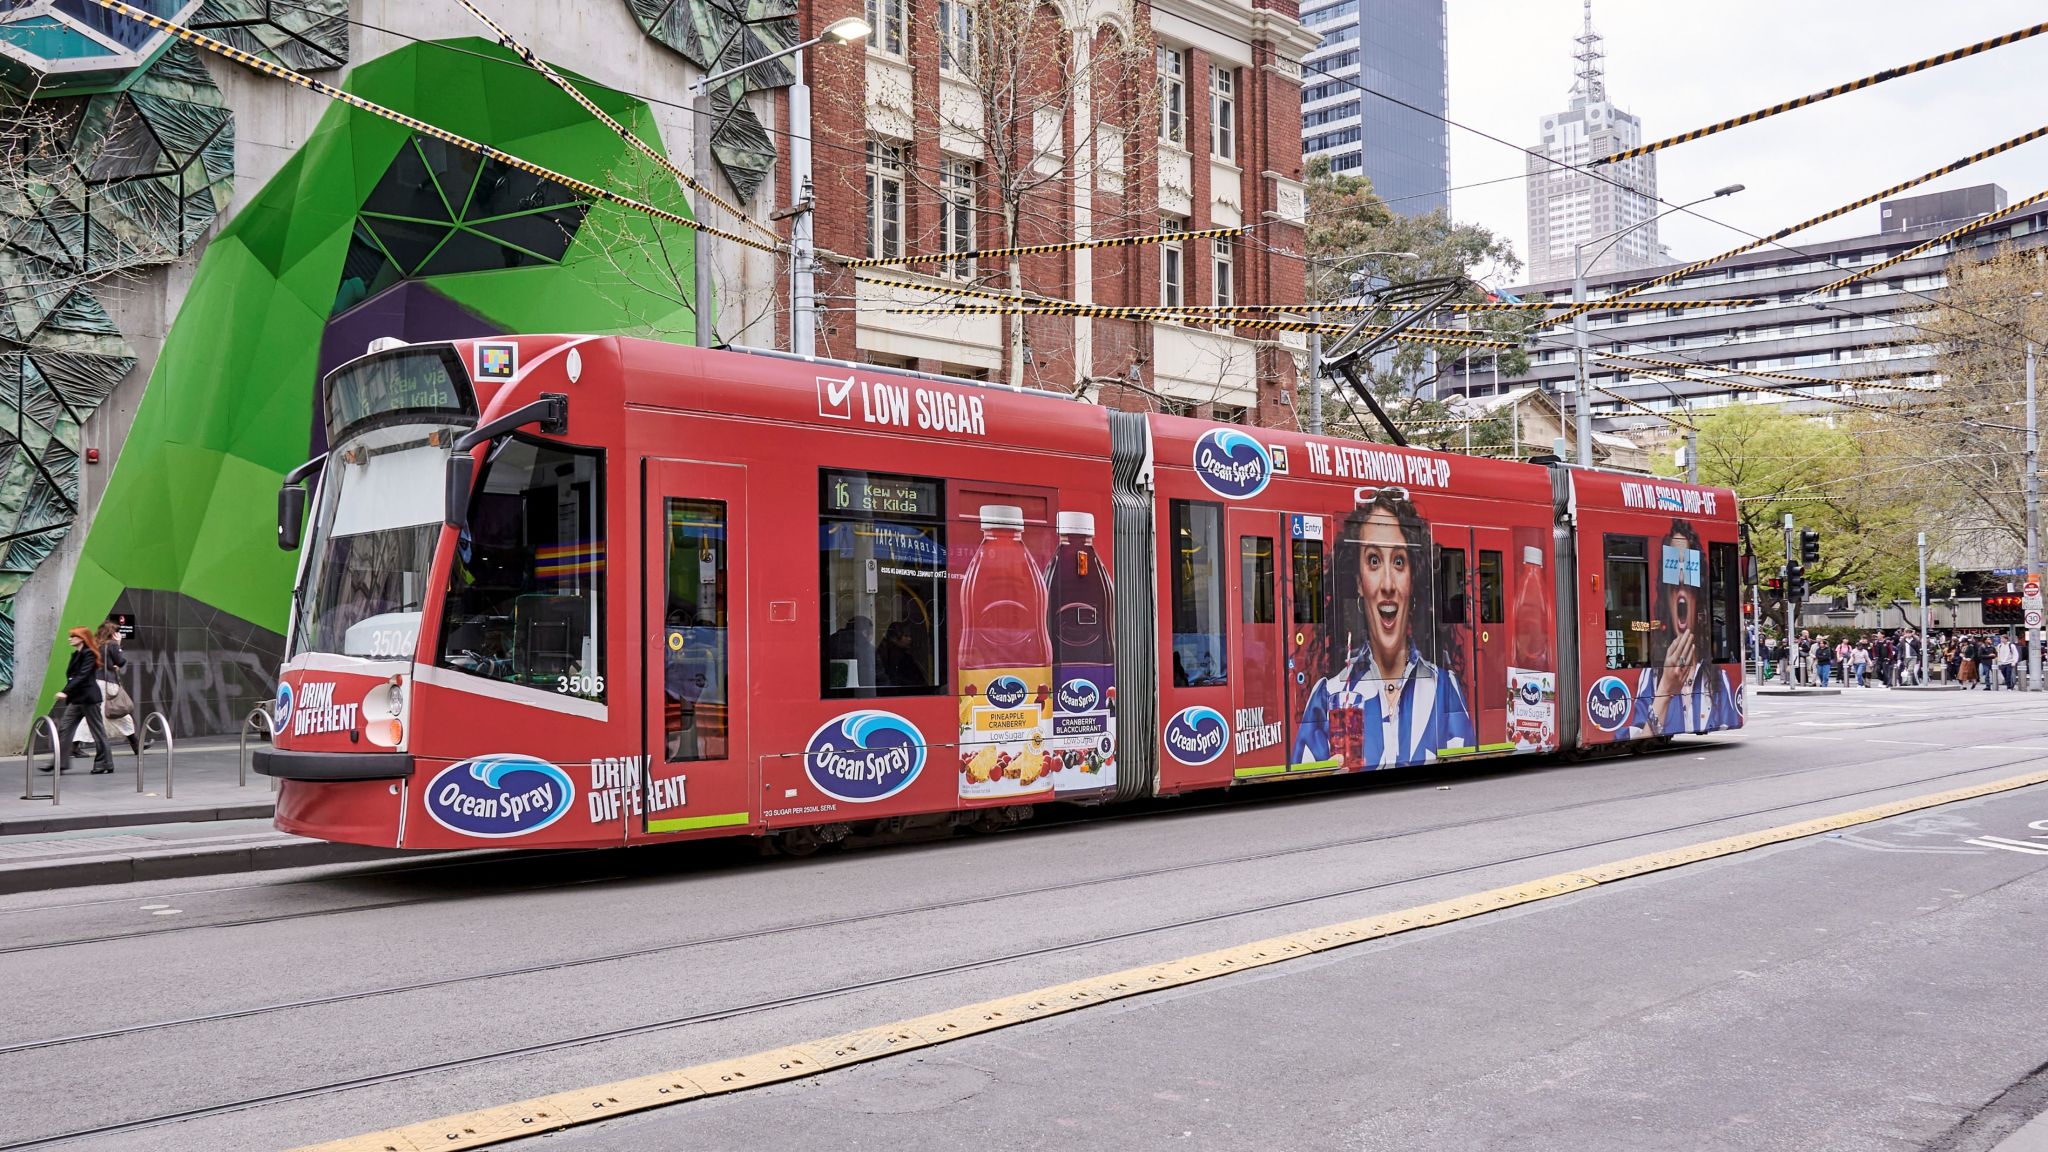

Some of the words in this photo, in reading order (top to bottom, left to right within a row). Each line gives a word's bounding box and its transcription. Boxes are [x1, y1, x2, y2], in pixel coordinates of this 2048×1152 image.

[424, 367, 446, 384] via
[411, 389, 448, 408] Kilda
[861, 381, 909, 427] LOW
[1200, 448, 1232, 481] Ocean
[1232, 455, 1262, 488] Spray
[1305, 441, 1332, 475] THE
[1335, 448, 1405, 484] AFTERNOON
[1407, 454, 1451, 488] PICK-UP
[835, 481, 849, 508] 16
[864, 484, 890, 497] Kew
[896, 486, 917, 499] via
[862, 497, 877, 509] St
[884, 499, 917, 512] Kilda
[1620, 482, 1644, 508] WITH
[1642, 484, 1656, 509] NO
[1655, 485, 1683, 512] SUGAR
[1681, 489, 1716, 515] DROP-OFF
[1304, 522, 1322, 535] Entry
[370, 630, 413, 657] 3506
[299, 682, 336, 708] DRINK
[557, 675, 605, 694] 3506
[1061, 690, 1078, 707] Ocean
[1078, 691, 1096, 708] Spray
[1591, 694, 1609, 719] Ocean
[1609, 694, 1625, 721] Spray
[295, 703, 359, 736] DIFFERENT
[988, 720, 1027, 728] CRANBERRY
[990, 712, 1025, 720] PINEAPPLE
[1061, 717, 1097, 726] CRANBERRY
[1235, 706, 1265, 731] DRINK
[1056, 725, 1102, 734] BLACKCURRANT
[1170, 726, 1197, 752] Ocean
[1197, 725, 1221, 755] Spray
[1235, 720, 1282, 755] DIFFERENT
[816, 743, 864, 781] Ocean
[866, 741, 910, 785] Spray
[438, 782, 498, 818] Ocean
[500, 782, 554, 822] Spray
[773, 808, 792, 816] SUGAR
[792, 806, 804, 814] PER
[803, 805, 820, 813] 250ML
[820, 803, 837, 811] SERVE
